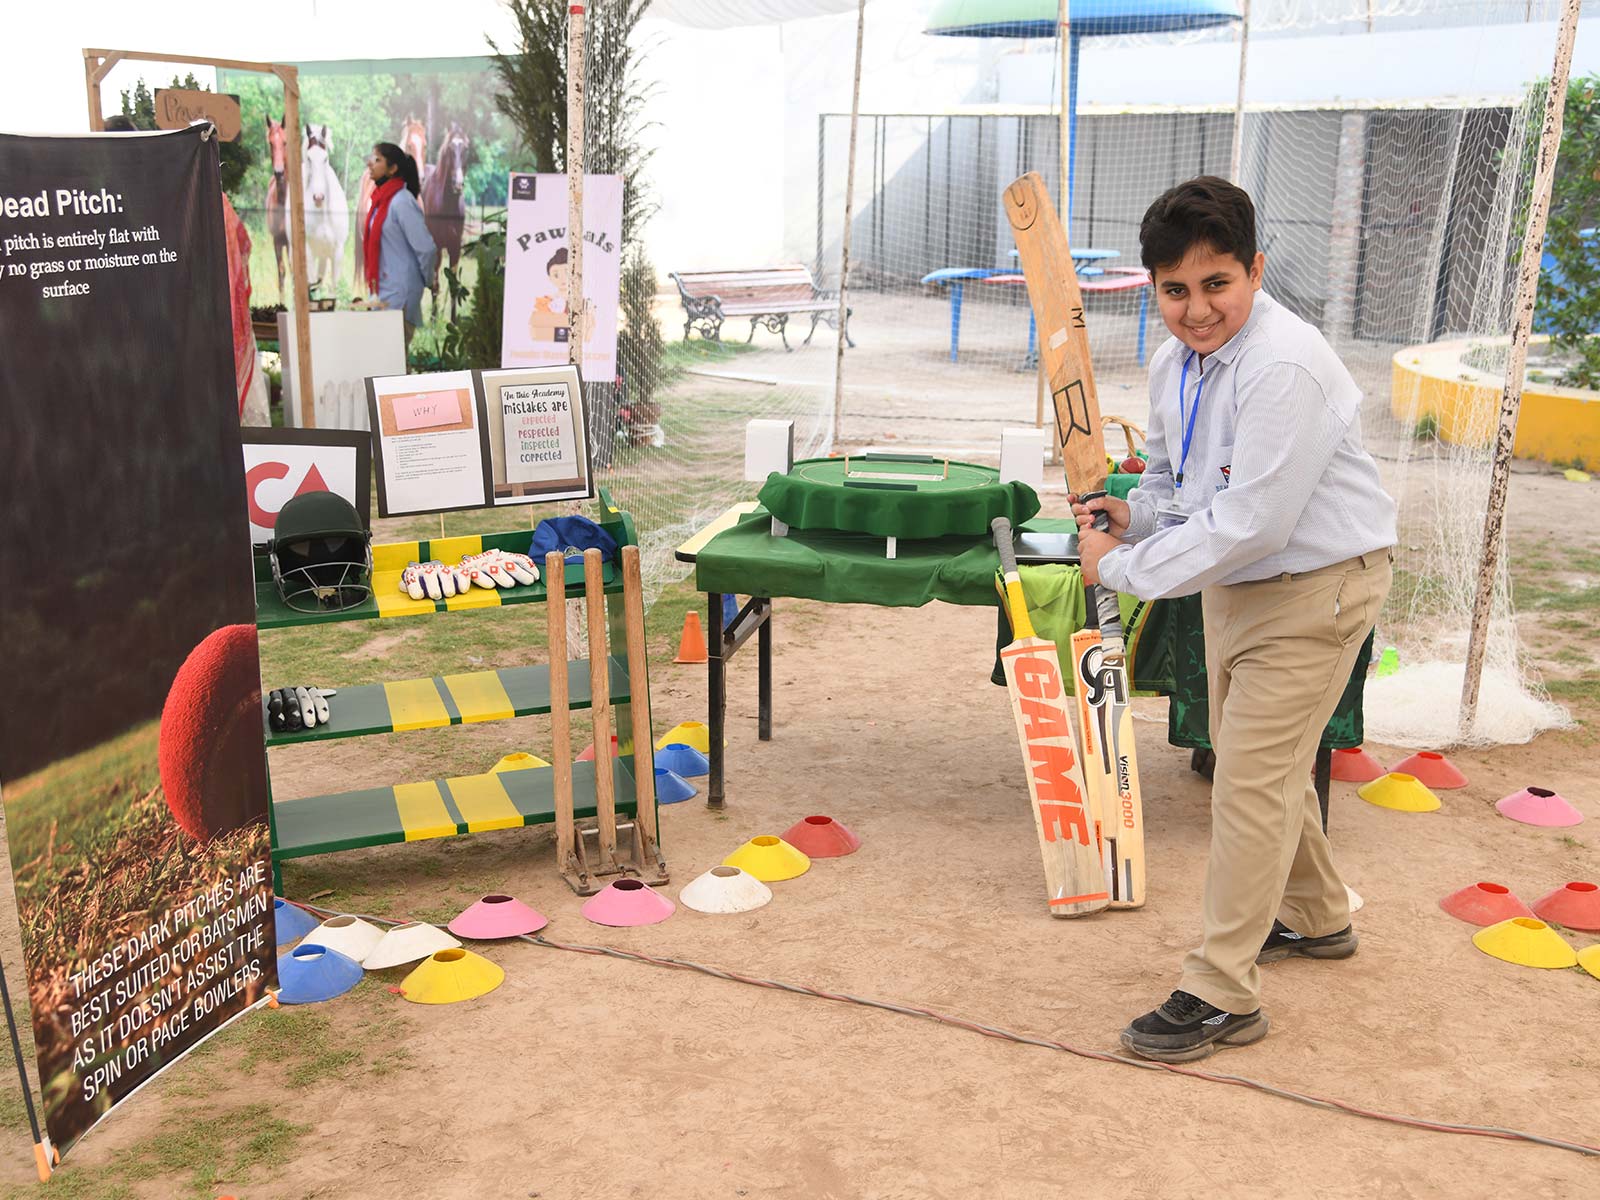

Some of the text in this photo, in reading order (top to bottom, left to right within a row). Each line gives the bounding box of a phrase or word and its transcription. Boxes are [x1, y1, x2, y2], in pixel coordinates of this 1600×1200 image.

[56, 188, 124, 216] Pitch:
[5, 232, 41, 256] pitch
[42, 233, 55, 249] is
[56, 229, 106, 250] entirely
[108, 227, 130, 244] flat
[131, 226, 160, 243] with
[8, 262, 27, 276] no
[30, 258, 65, 280] grass
[67, 258, 82, 271] or
[84, 253, 140, 270] moisture
[142, 251, 158, 265] on
[159, 247, 178, 263] the
[42, 280, 90, 298] surface
[503, 388, 565, 401] In this Academy
[503, 400, 568, 415] mistakes are
[413, 404, 438, 417] WHY
[518, 426, 560, 439] respected
[520, 439, 560, 451] inspected
[520, 451, 562, 463] corrected
[1014, 656, 1090, 846] GAME
[1120, 791, 1135, 829] 3000
[69, 860, 266, 998] THESE DARK PITCHES ARE
[71, 892, 267, 1038] BEST SUITED FOR BATSMEN
[72, 924, 264, 1072] AS IT DOESN'T ASSIST THE
[83, 959, 264, 1102] SPIN OR PACE BOWLERS.
